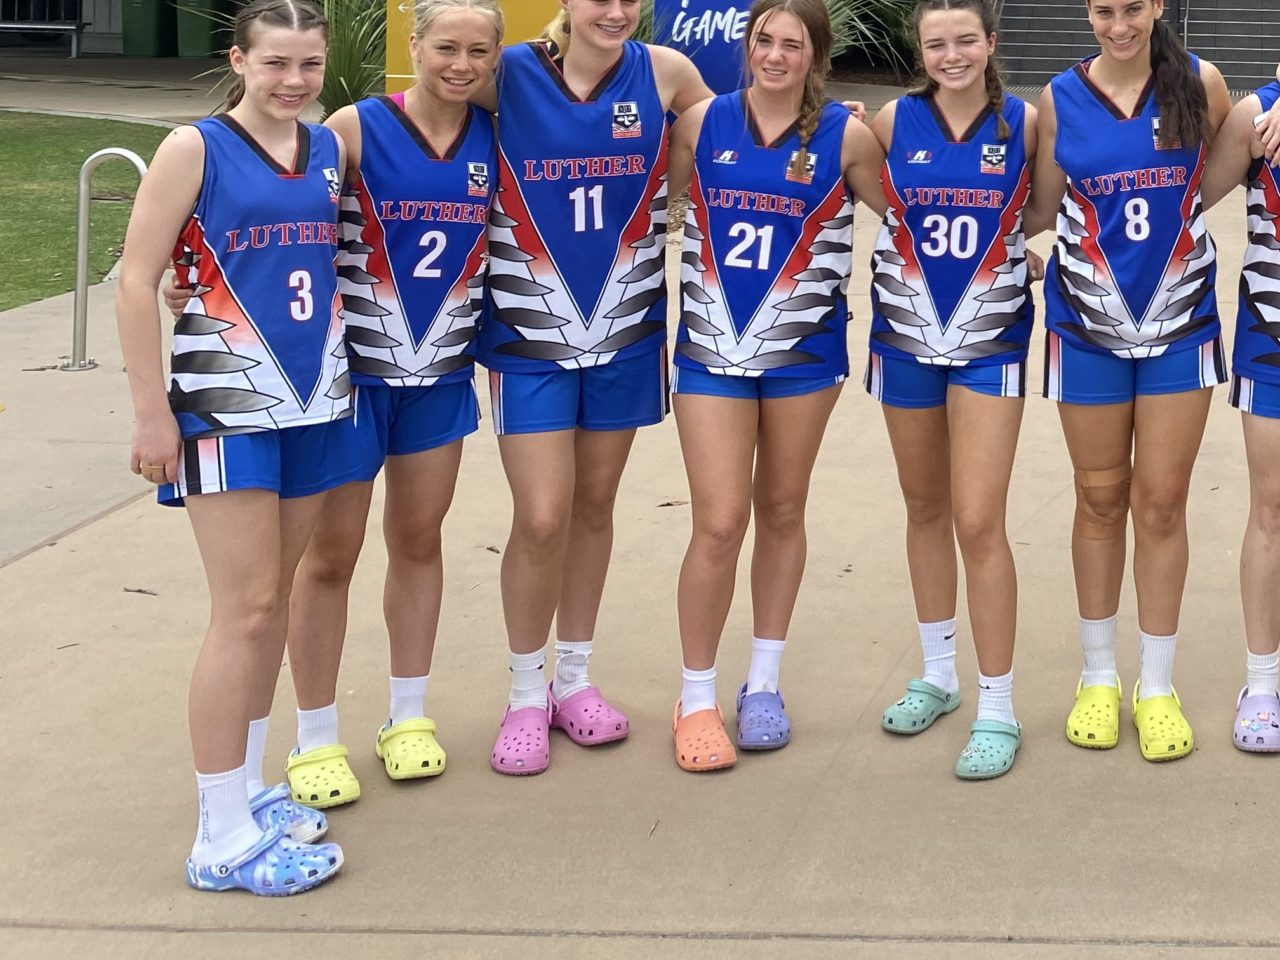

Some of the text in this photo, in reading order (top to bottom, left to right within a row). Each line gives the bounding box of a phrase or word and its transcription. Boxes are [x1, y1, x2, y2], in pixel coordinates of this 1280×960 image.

[672, 7, 751, 46] GAME
[523, 155, 646, 181] LUTHER
[1081, 166, 1187, 196] LUTHER
[380, 201, 486, 224] LUTHER
[568, 184, 604, 233] 11
[708, 188, 806, 218] LUTHER
[903, 187, 1004, 208] LUTHER
[921, 214, 979, 259] 30
[1123, 197, 1150, 242] 8
[412, 230, 448, 278] 2
[724, 222, 774, 271] 21
[288, 270, 314, 321] 3
